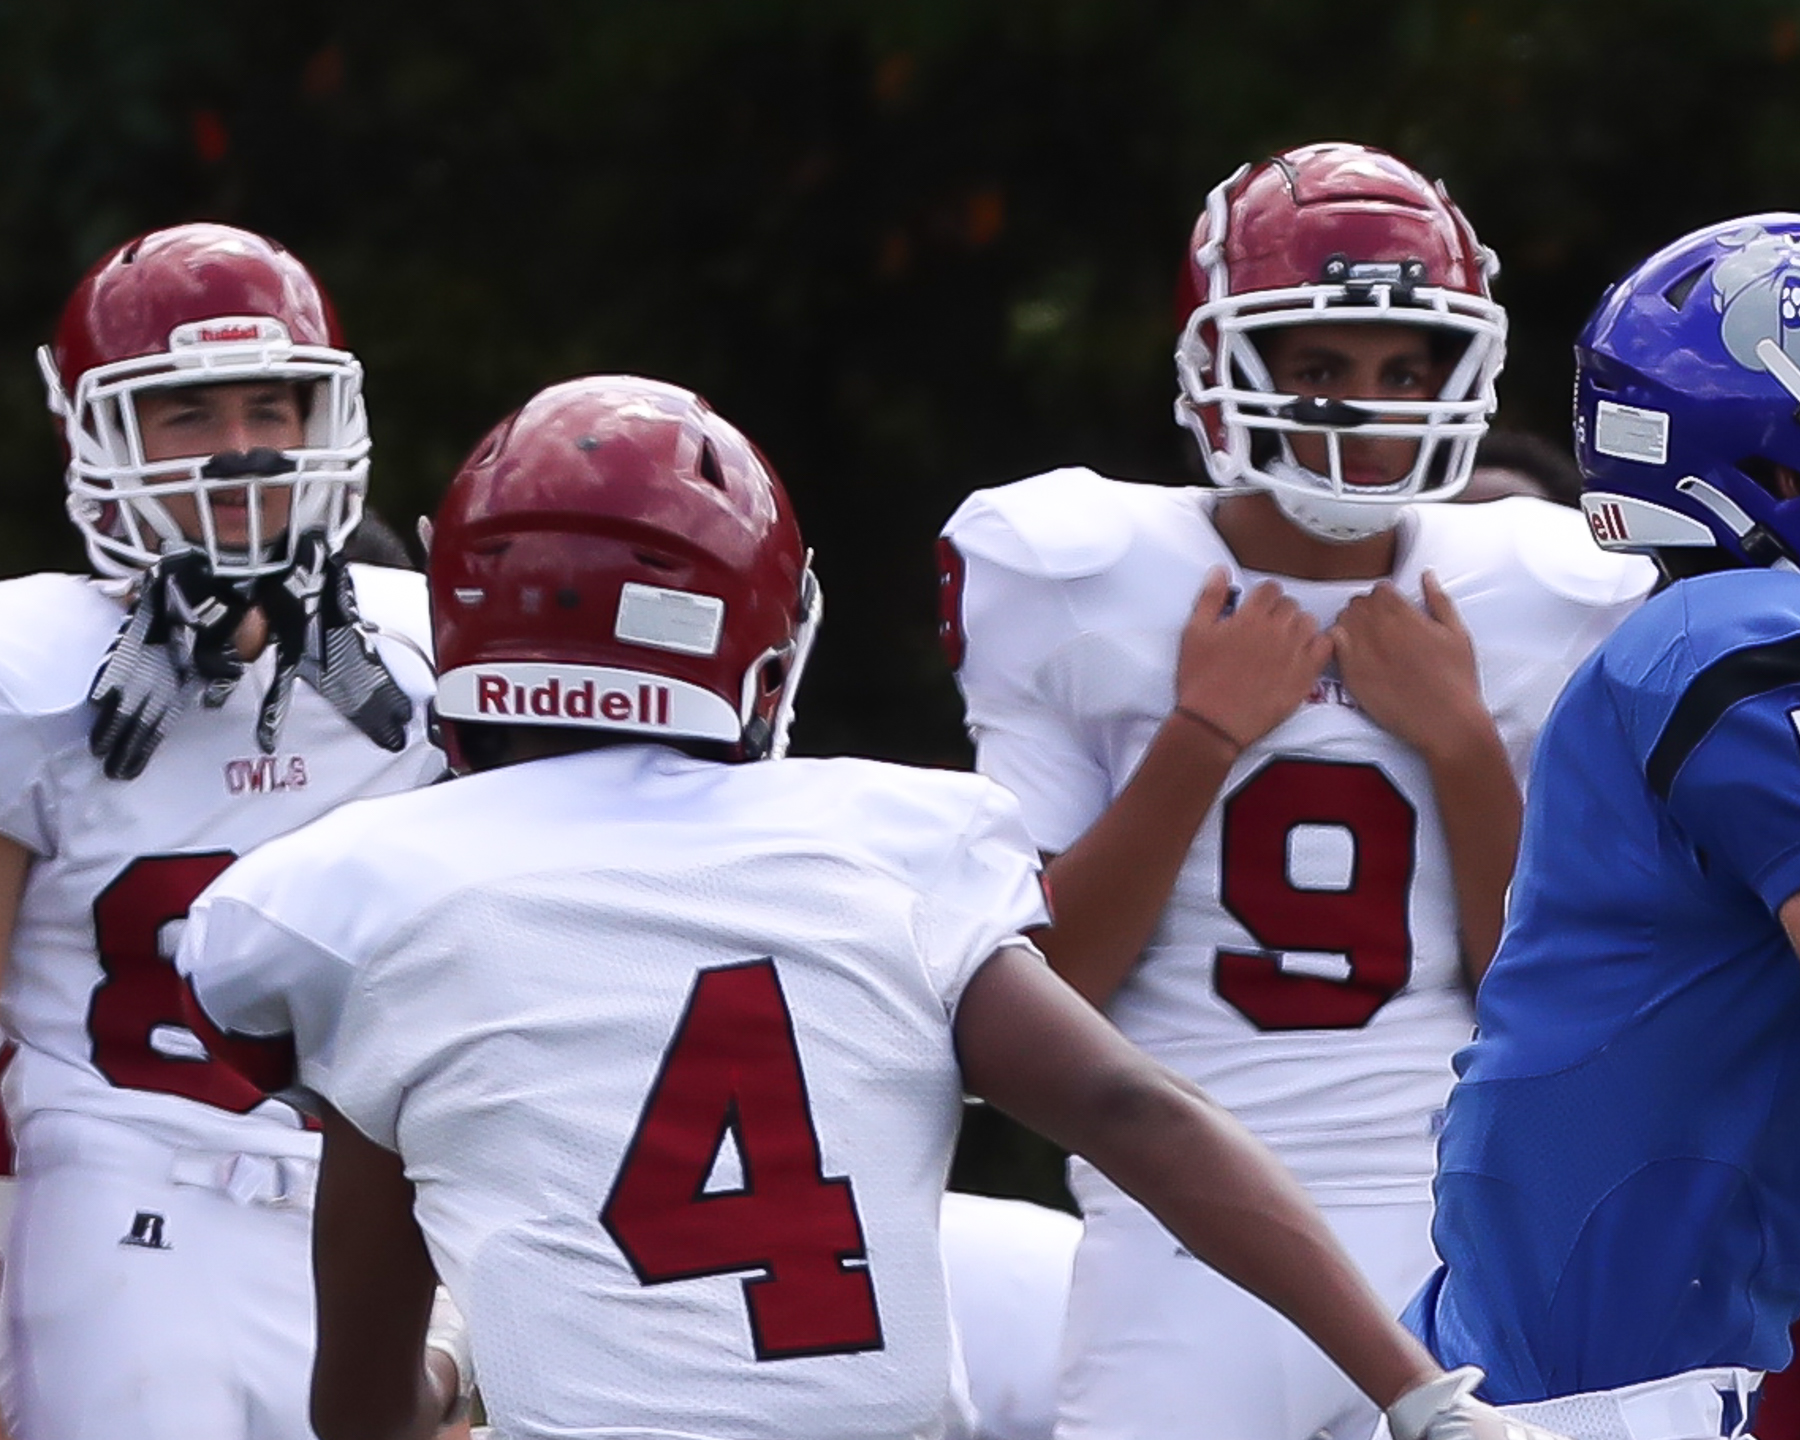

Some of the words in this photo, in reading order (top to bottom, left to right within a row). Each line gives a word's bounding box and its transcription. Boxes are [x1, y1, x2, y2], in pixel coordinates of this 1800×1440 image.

[475, 673, 670, 726] Riddell
[1214, 757, 1417, 1032] 9
[600, 956, 884, 1361] 4
